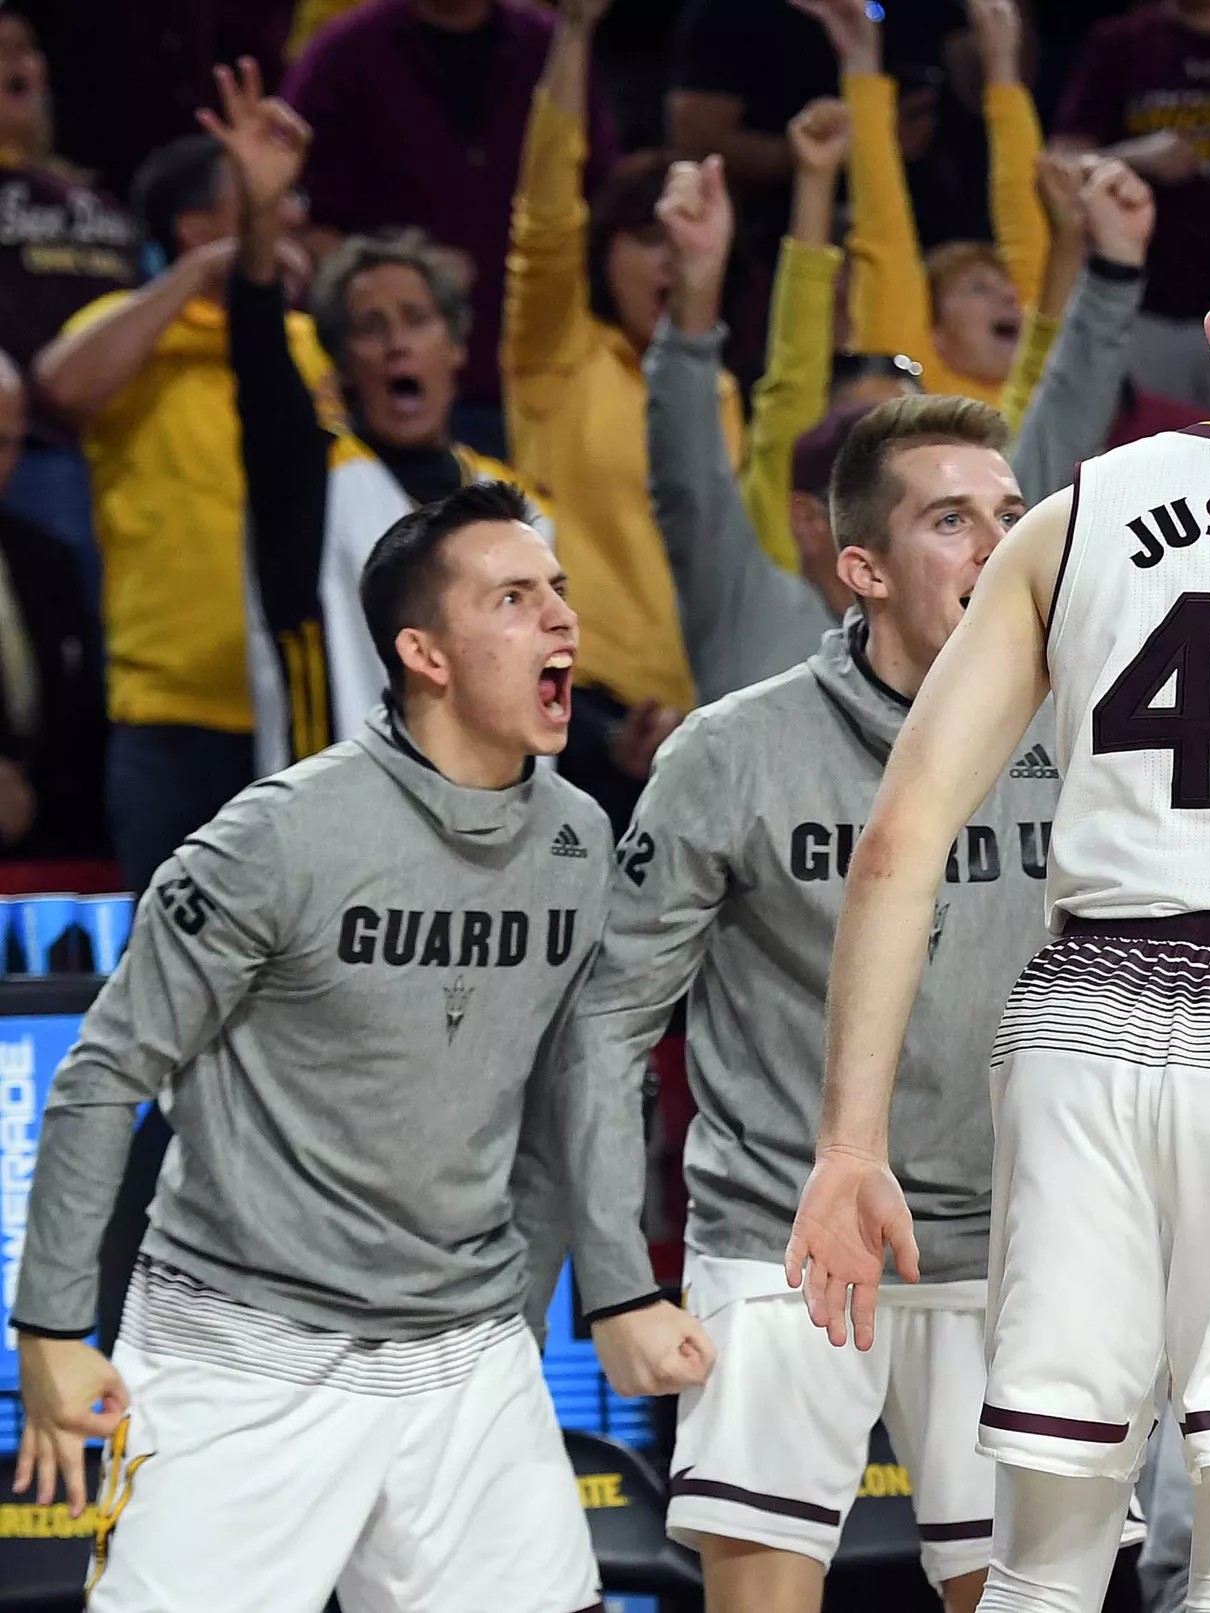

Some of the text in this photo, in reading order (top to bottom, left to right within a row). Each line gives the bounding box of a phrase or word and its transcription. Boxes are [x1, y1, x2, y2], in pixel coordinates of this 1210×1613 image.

[1009, 765, 1060, 779] adidas
[1018, 822, 1053, 880] U
[337, 905, 578, 968] GUARD U
